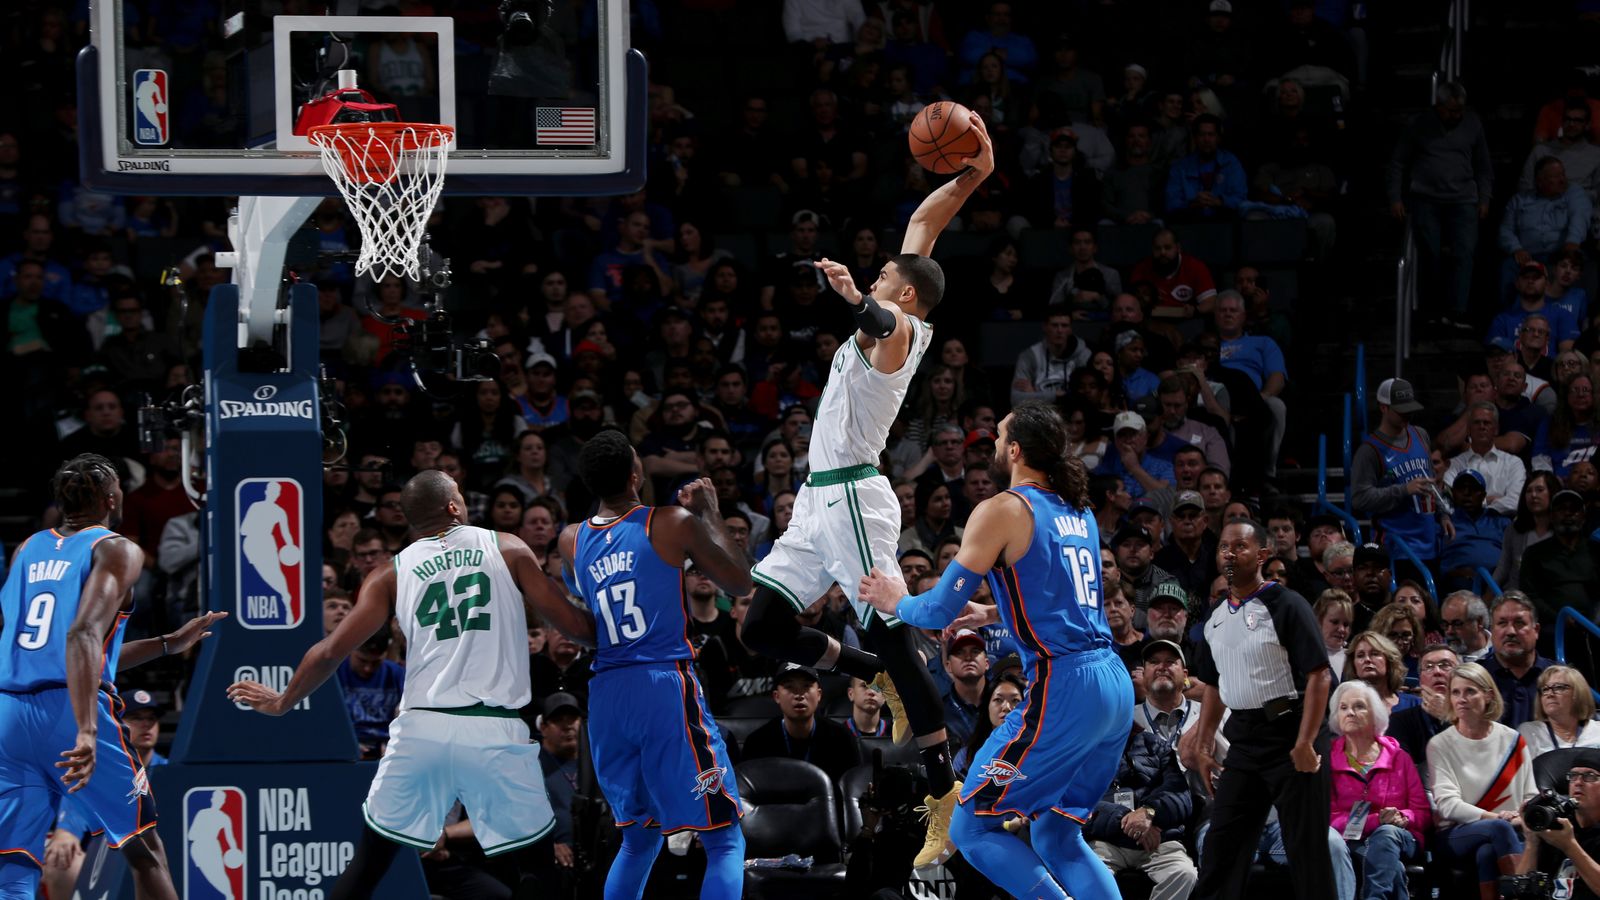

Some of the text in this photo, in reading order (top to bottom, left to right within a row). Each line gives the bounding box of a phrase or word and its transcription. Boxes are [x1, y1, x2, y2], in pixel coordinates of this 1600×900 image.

[118, 160, 170, 172] SPALDING
[219, 400, 313, 419] SPALDING
[1053, 515, 1089, 539] ADAMS
[28, 560, 72, 583] GRANT
[412, 549, 484, 582] HORFORD
[588, 551, 635, 584] GEORGE
[1061, 545, 1099, 610] 12
[17, 591, 56, 651] 9
[247, 595, 280, 619] NBA
[415, 571, 491, 641] 42
[596, 579, 648, 646] 13
[258, 788, 312, 832] NBA
[259, 834, 355, 886] League
